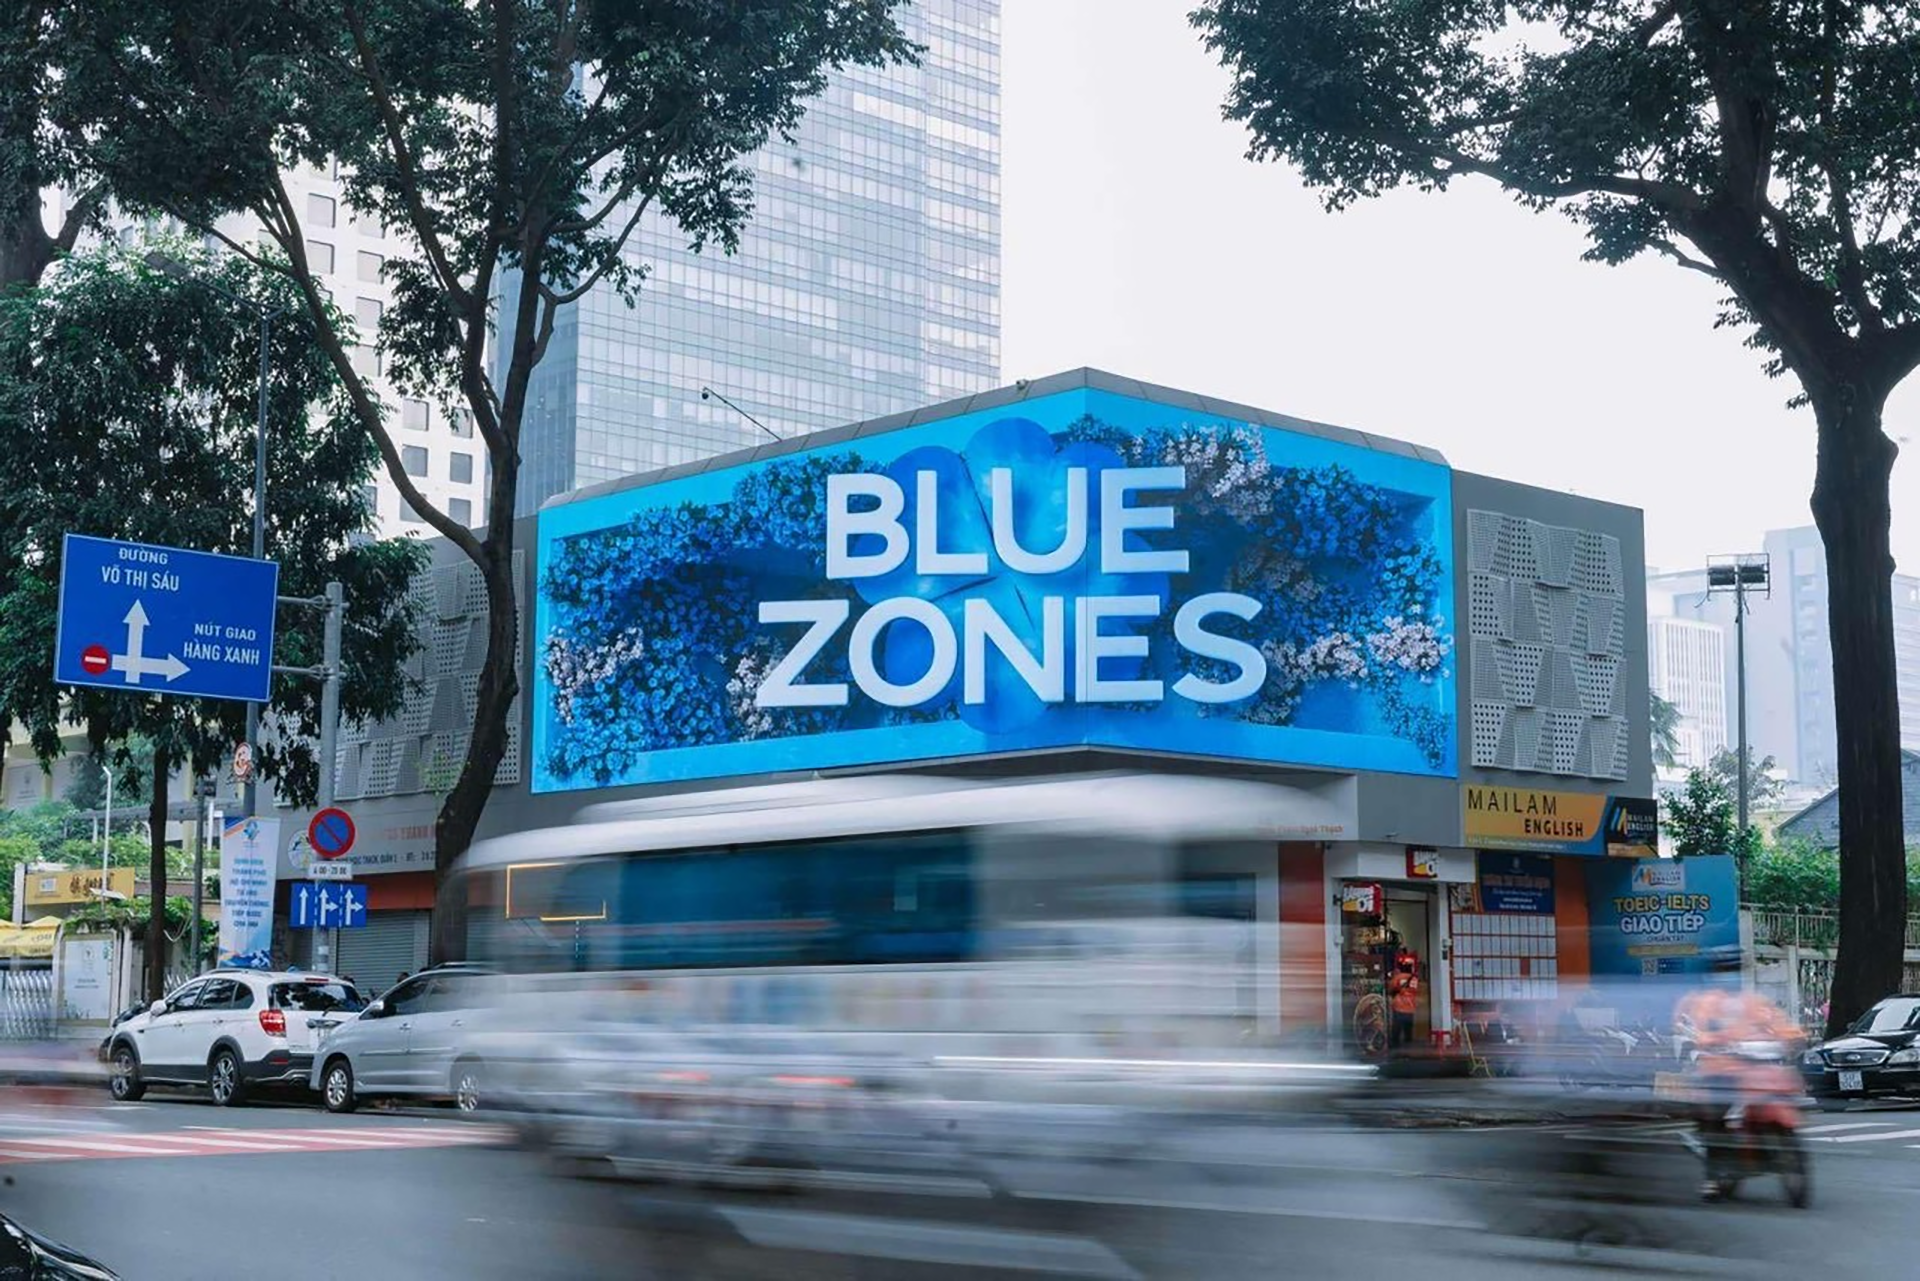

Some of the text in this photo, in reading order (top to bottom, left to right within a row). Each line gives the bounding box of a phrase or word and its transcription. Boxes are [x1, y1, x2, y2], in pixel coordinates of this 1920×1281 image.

[826, 465, 1189, 579] BLUE
[119, 547, 168, 565] ĐƯỜNG
[101, 563, 180, 592] VÕ THỊ SÁU
[194, 622, 257, 641] NÚT GIAO
[183, 638, 260, 665] HÀNG XANH
[757, 591, 1268, 707] ZONES
[1468, 788, 1557, 816] MAILAM
[1524, 818, 1584, 837] ENGLISH
[1620, 909, 1705, 933] GIAO TIẾP
